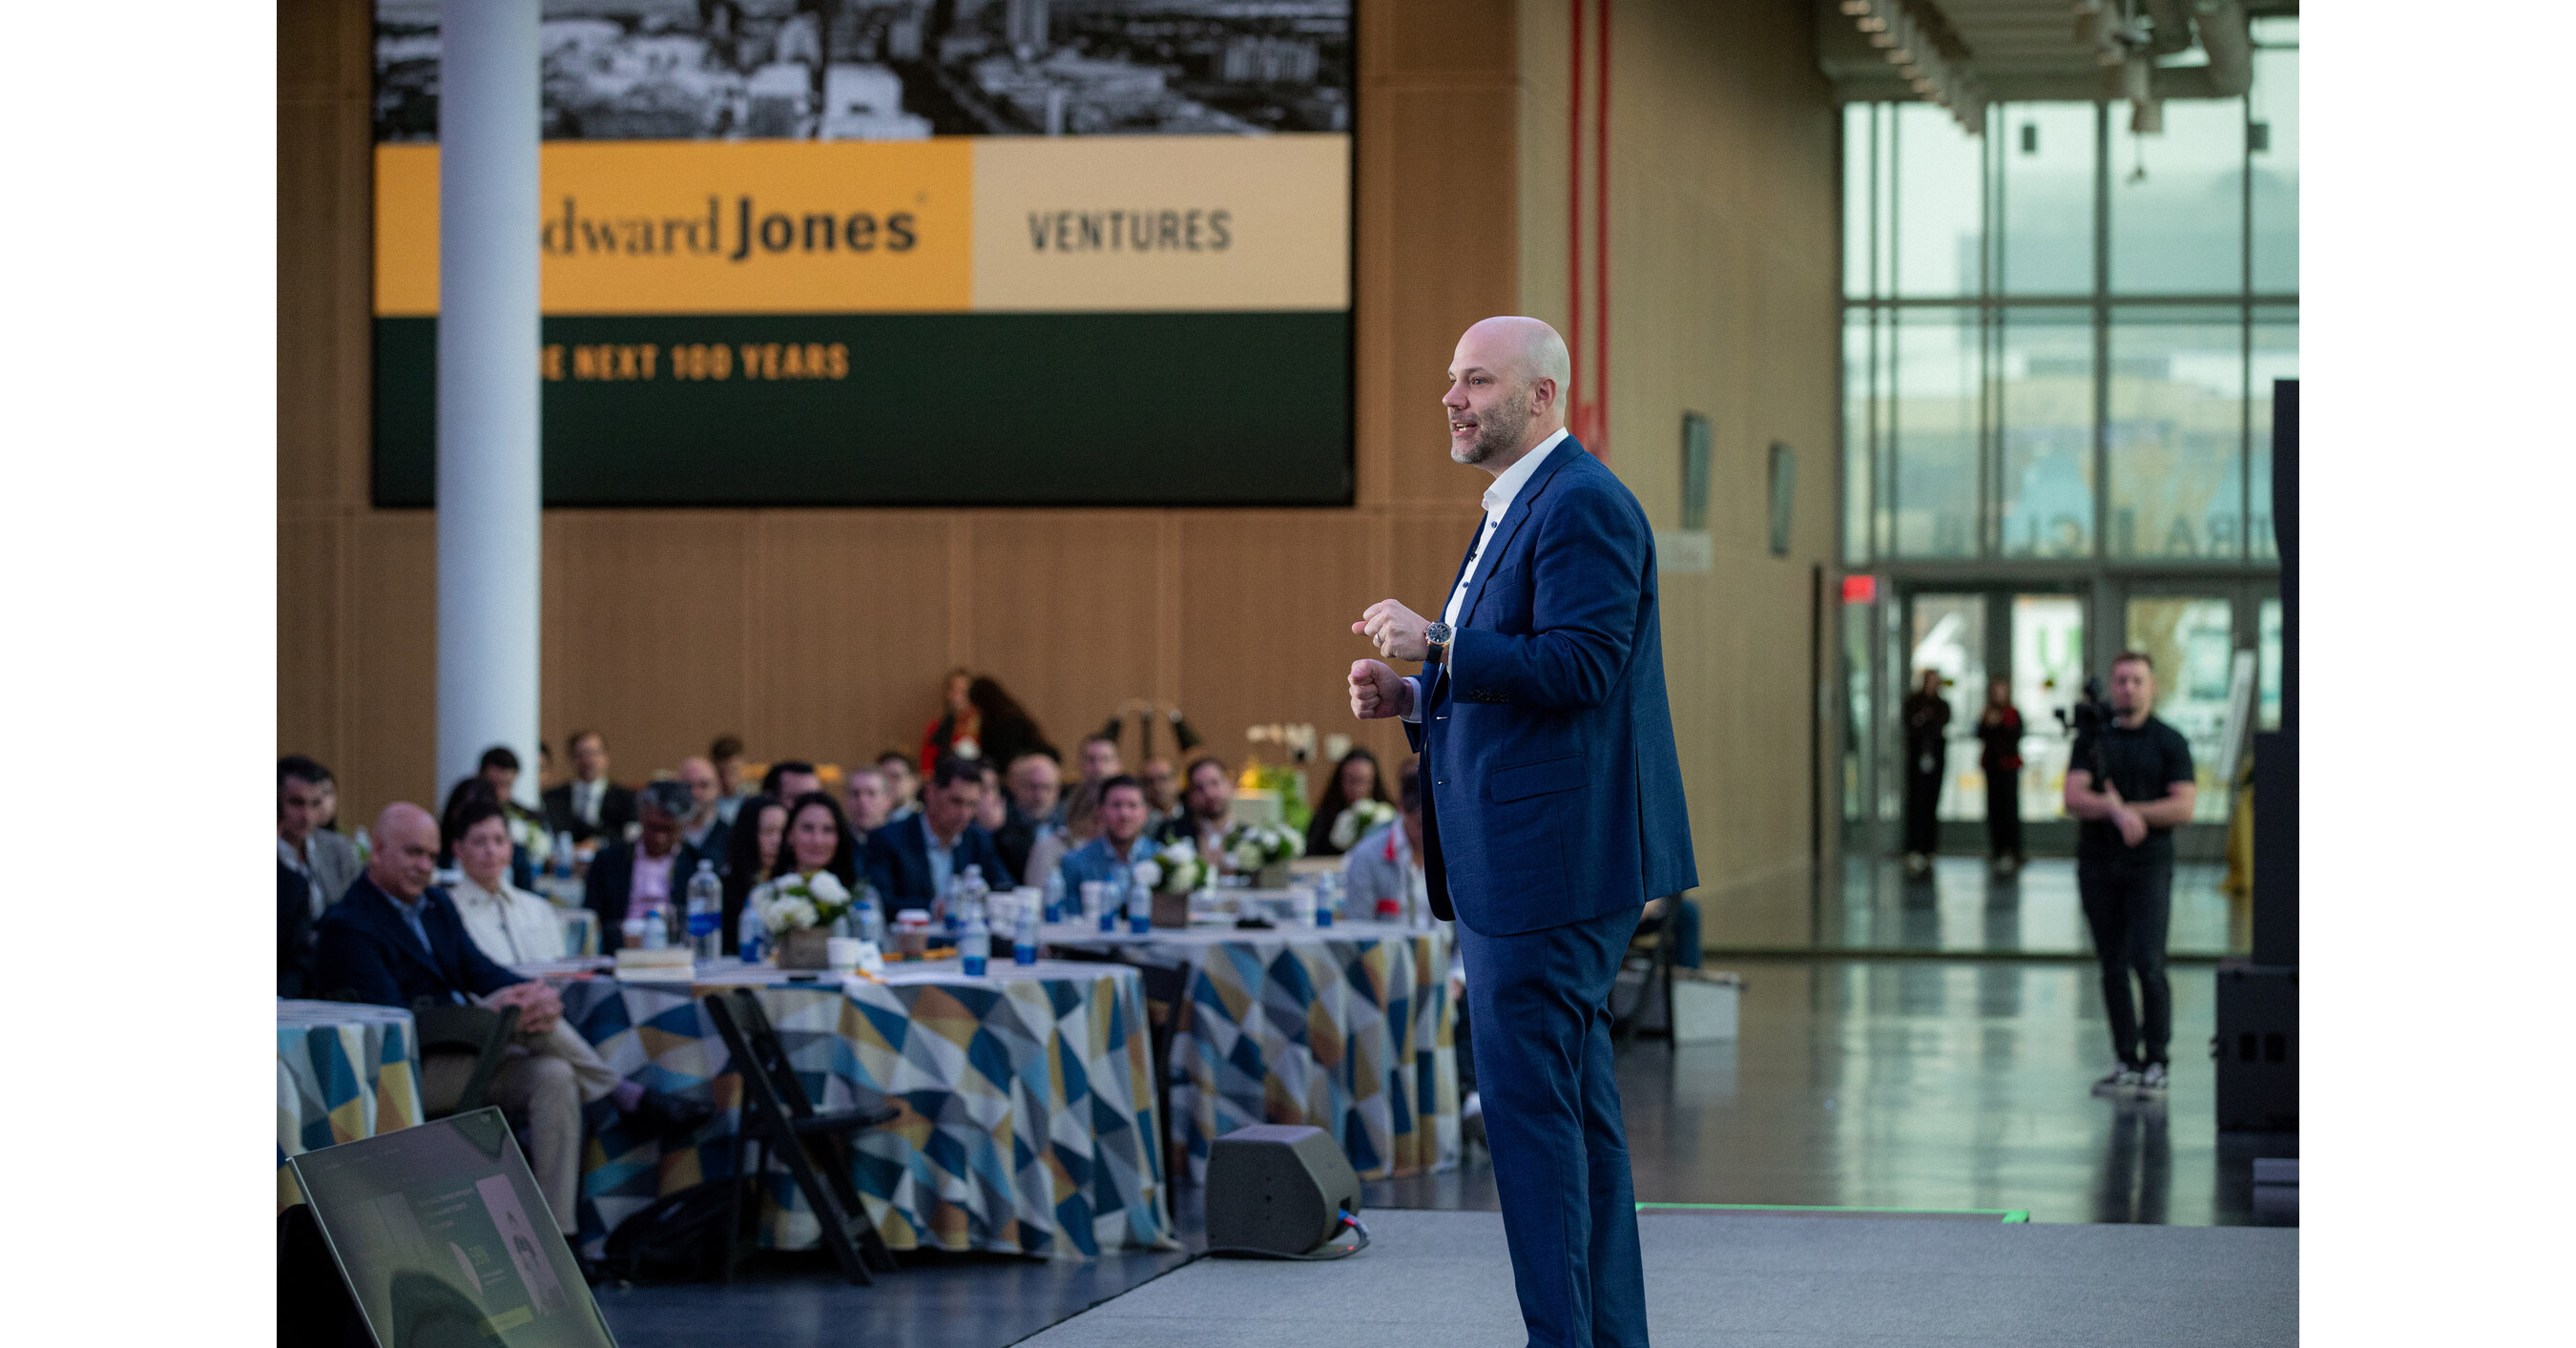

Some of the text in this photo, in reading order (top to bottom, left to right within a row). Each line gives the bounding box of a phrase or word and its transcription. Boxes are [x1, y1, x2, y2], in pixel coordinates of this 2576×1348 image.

[541, 197, 916, 263] dward Jones
[1028, 209, 1234, 252] VENTURES
[573, 343, 658, 381] NEXT
[672, 343, 733, 381] 100
[741, 342, 850, 381] YEARS
